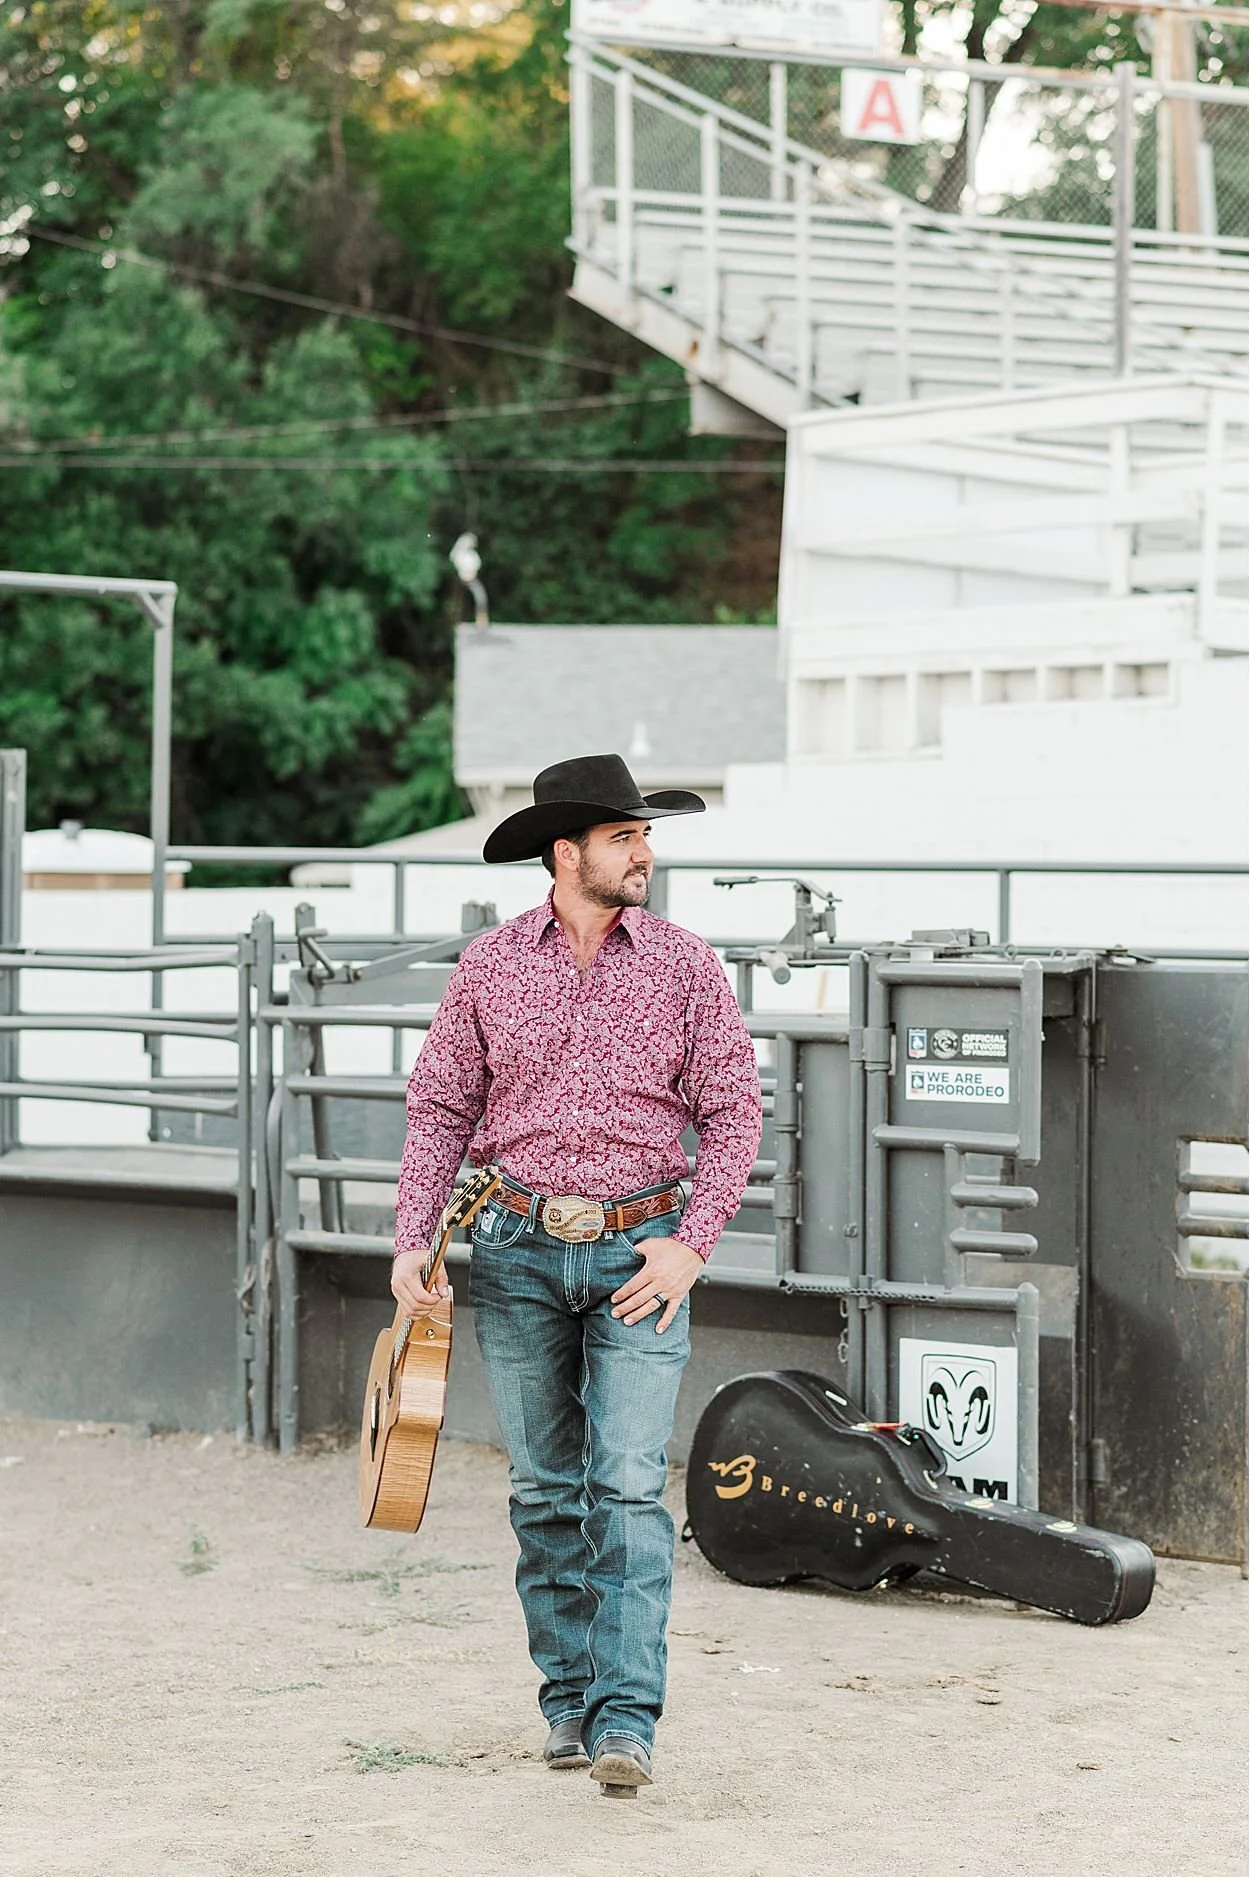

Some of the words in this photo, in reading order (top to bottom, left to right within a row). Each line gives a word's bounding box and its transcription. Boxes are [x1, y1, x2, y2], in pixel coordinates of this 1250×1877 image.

[857, 78, 905, 135] A
[927, 1072, 949, 1082] WE
[954, 1073, 982, 1083] ARE
[927, 1084, 1004, 1097] PRORODEO
[946, 1474, 1009, 1501] AM
[760, 1475, 915, 1535] Breedlove
